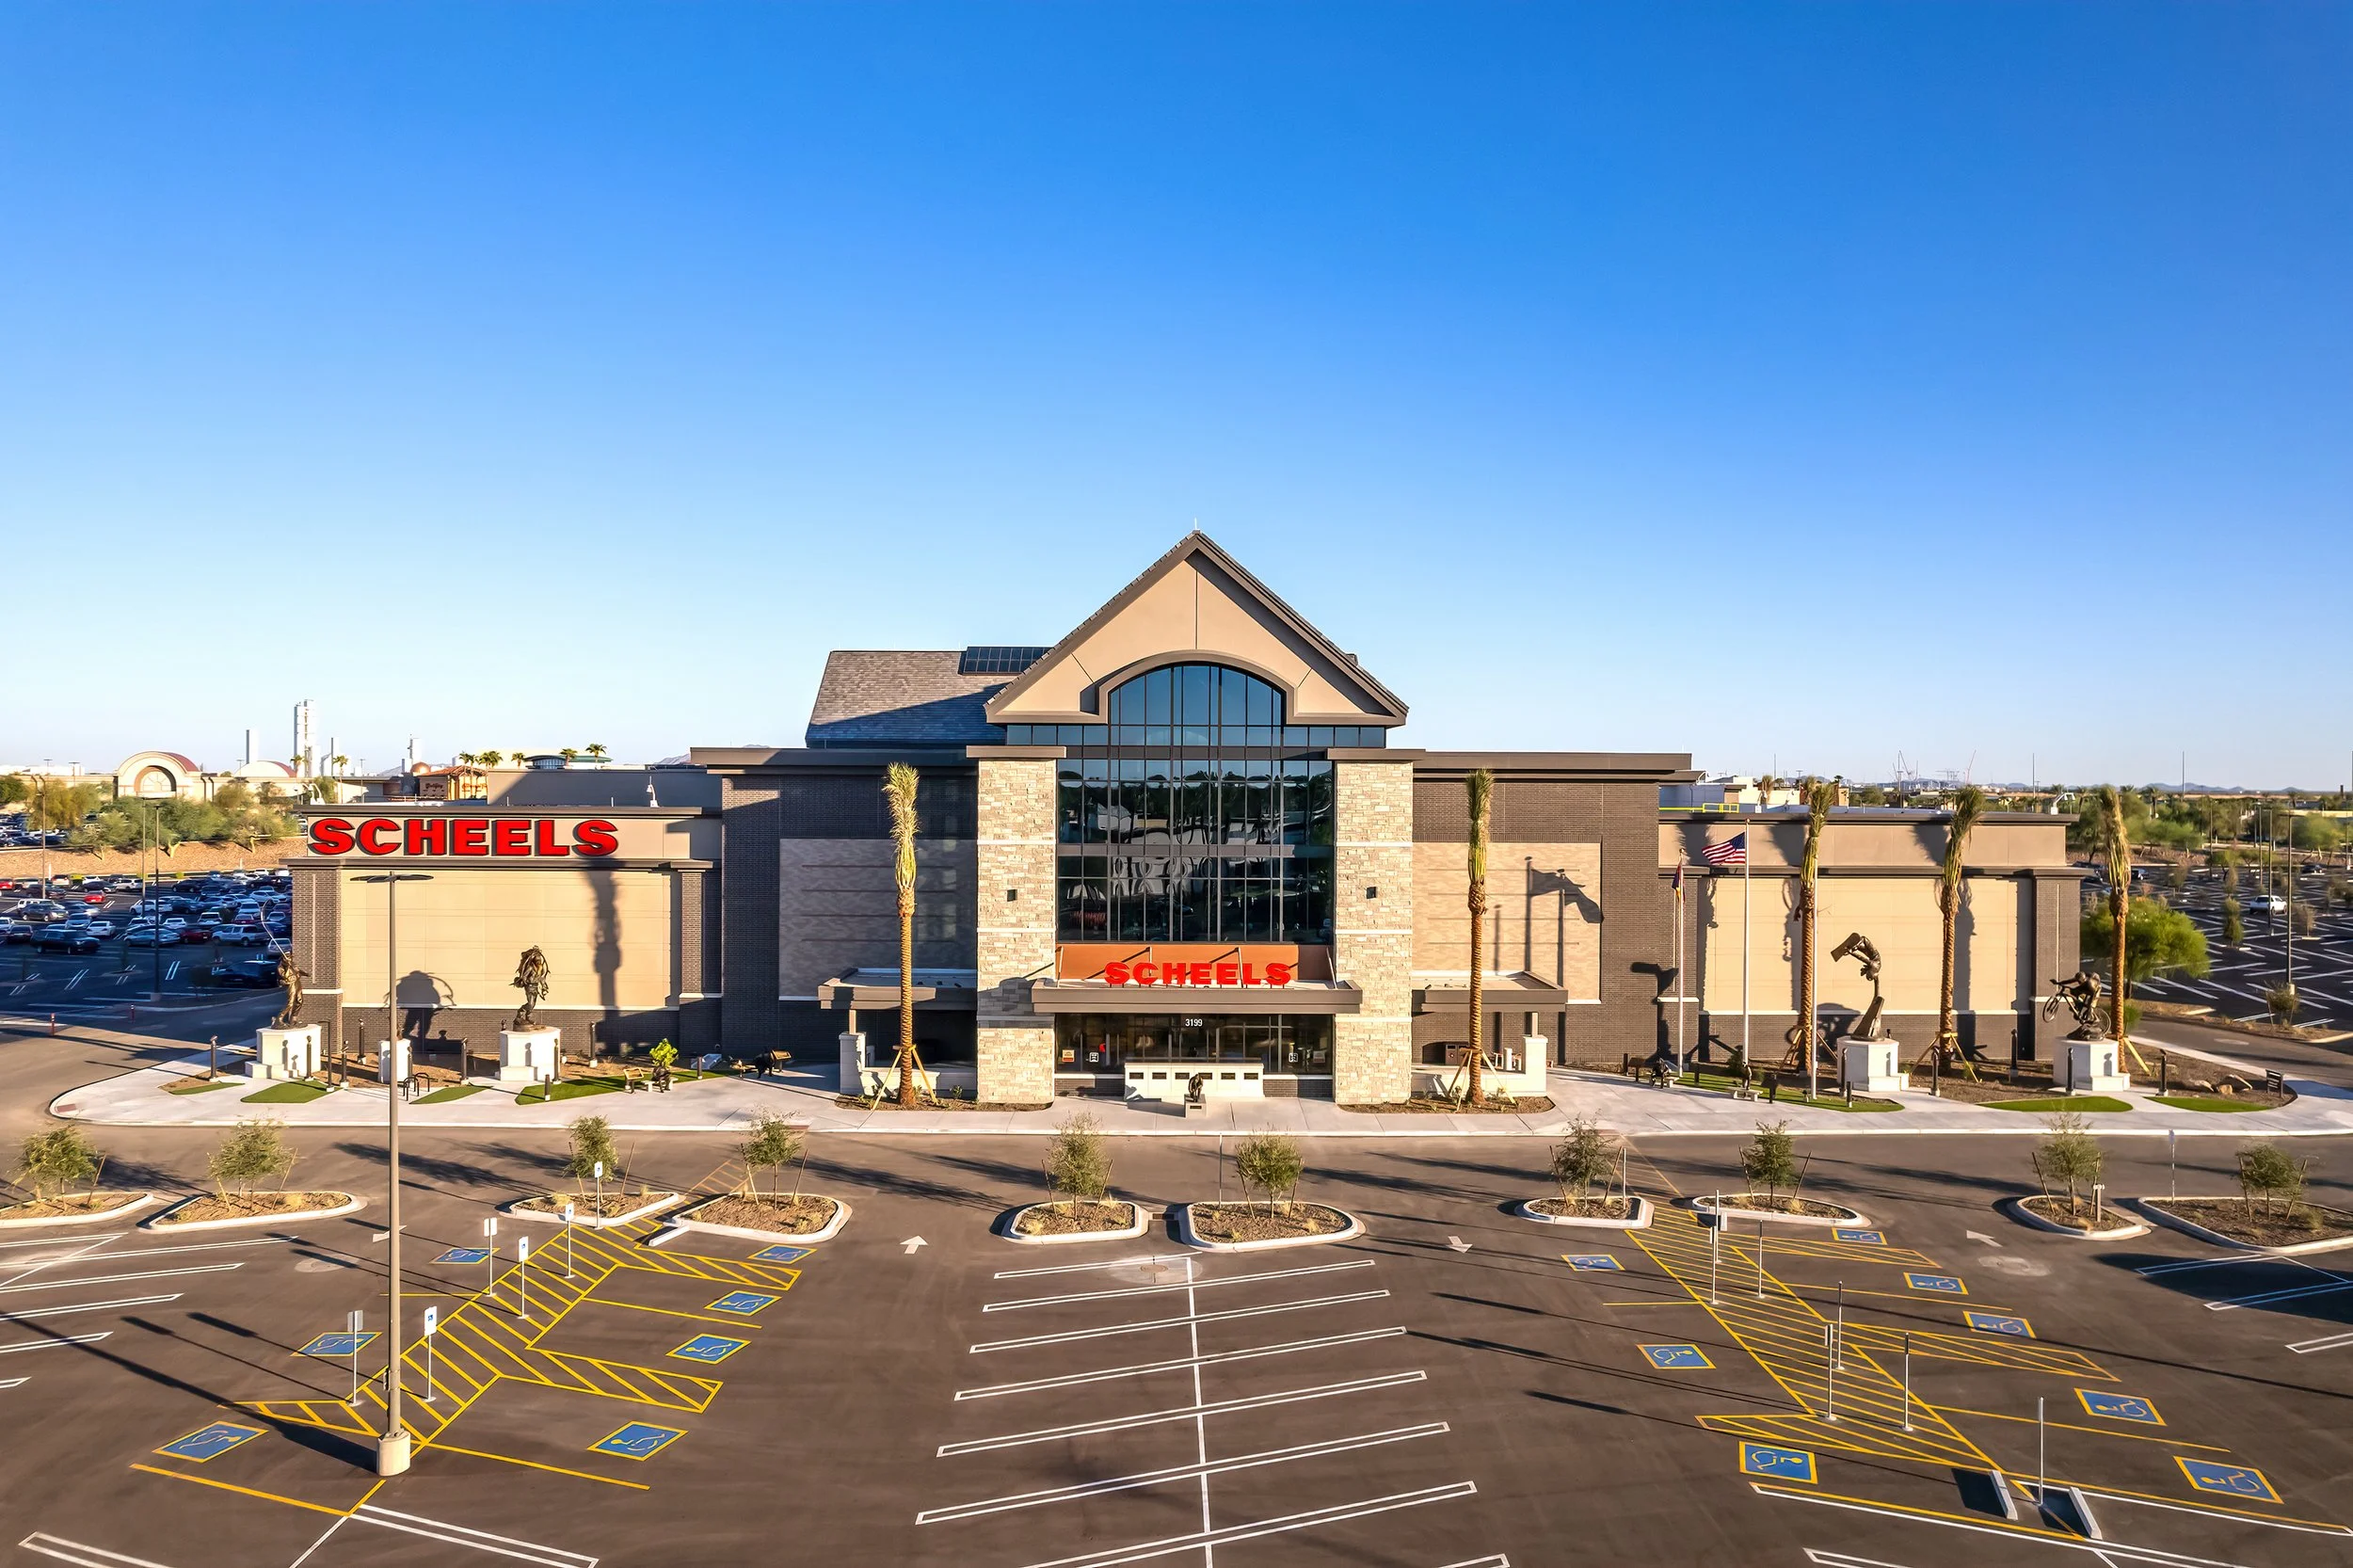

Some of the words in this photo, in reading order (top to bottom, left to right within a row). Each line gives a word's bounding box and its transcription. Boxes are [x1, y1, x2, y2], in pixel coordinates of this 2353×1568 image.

[310, 818, 617, 856] SCHEELS
[1104, 962, 1291, 985] SCHEELS
[1185, 1018, 1203, 1027] 3199
